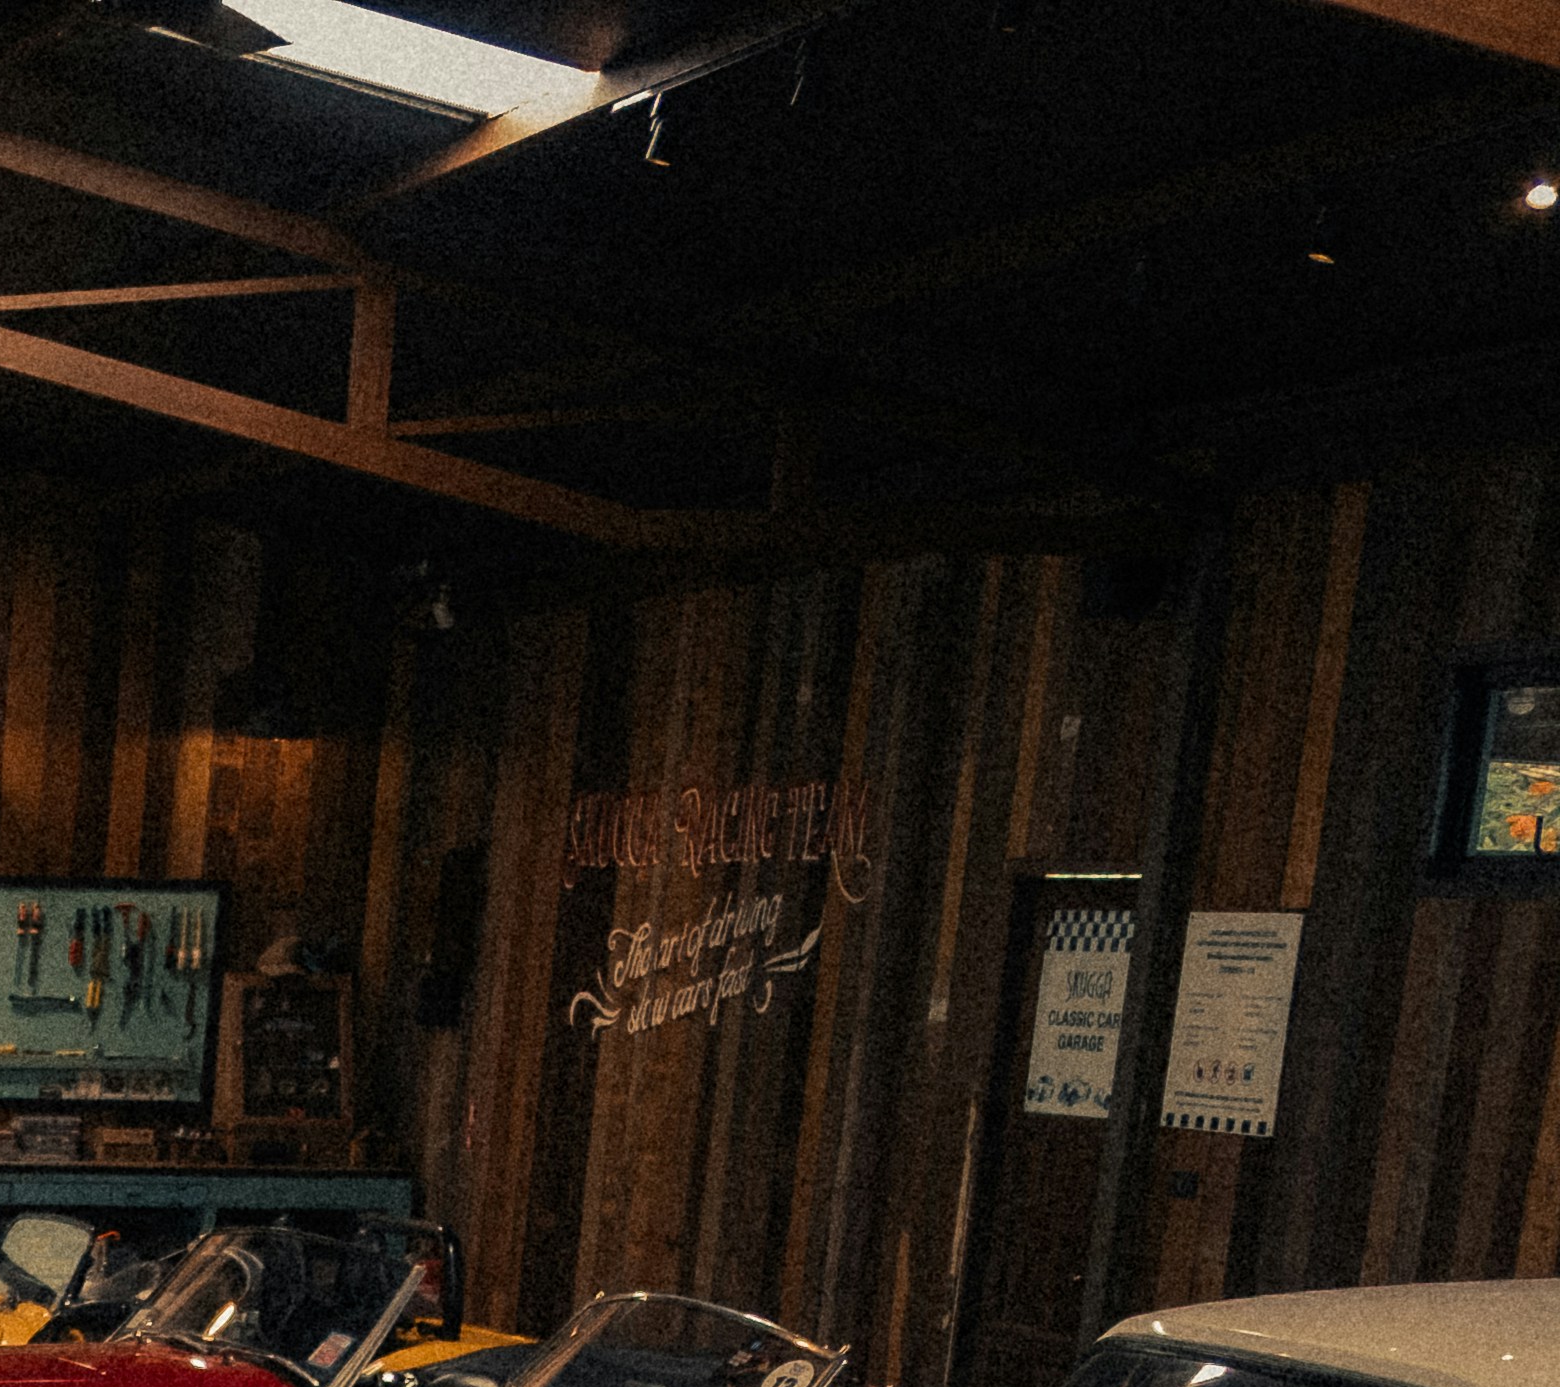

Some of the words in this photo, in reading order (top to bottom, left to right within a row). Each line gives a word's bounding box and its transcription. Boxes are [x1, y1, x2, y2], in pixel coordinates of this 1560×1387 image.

[674, 786, 780, 878] RACING
[787, 781, 872, 904] TEAM
[608, 921, 653, 989] The
[709, 891, 783, 948] driving
[671, 977, 713, 1021] cars
[709, 946, 755, 1027] fast
[1065, 969, 1113, 1005] SKUGGA
[1048, 1009, 1095, 1028] CLASSIC
[1097, 1011, 1120, 1029] CAR
[1057, 1034, 1105, 1052] GARAGE
